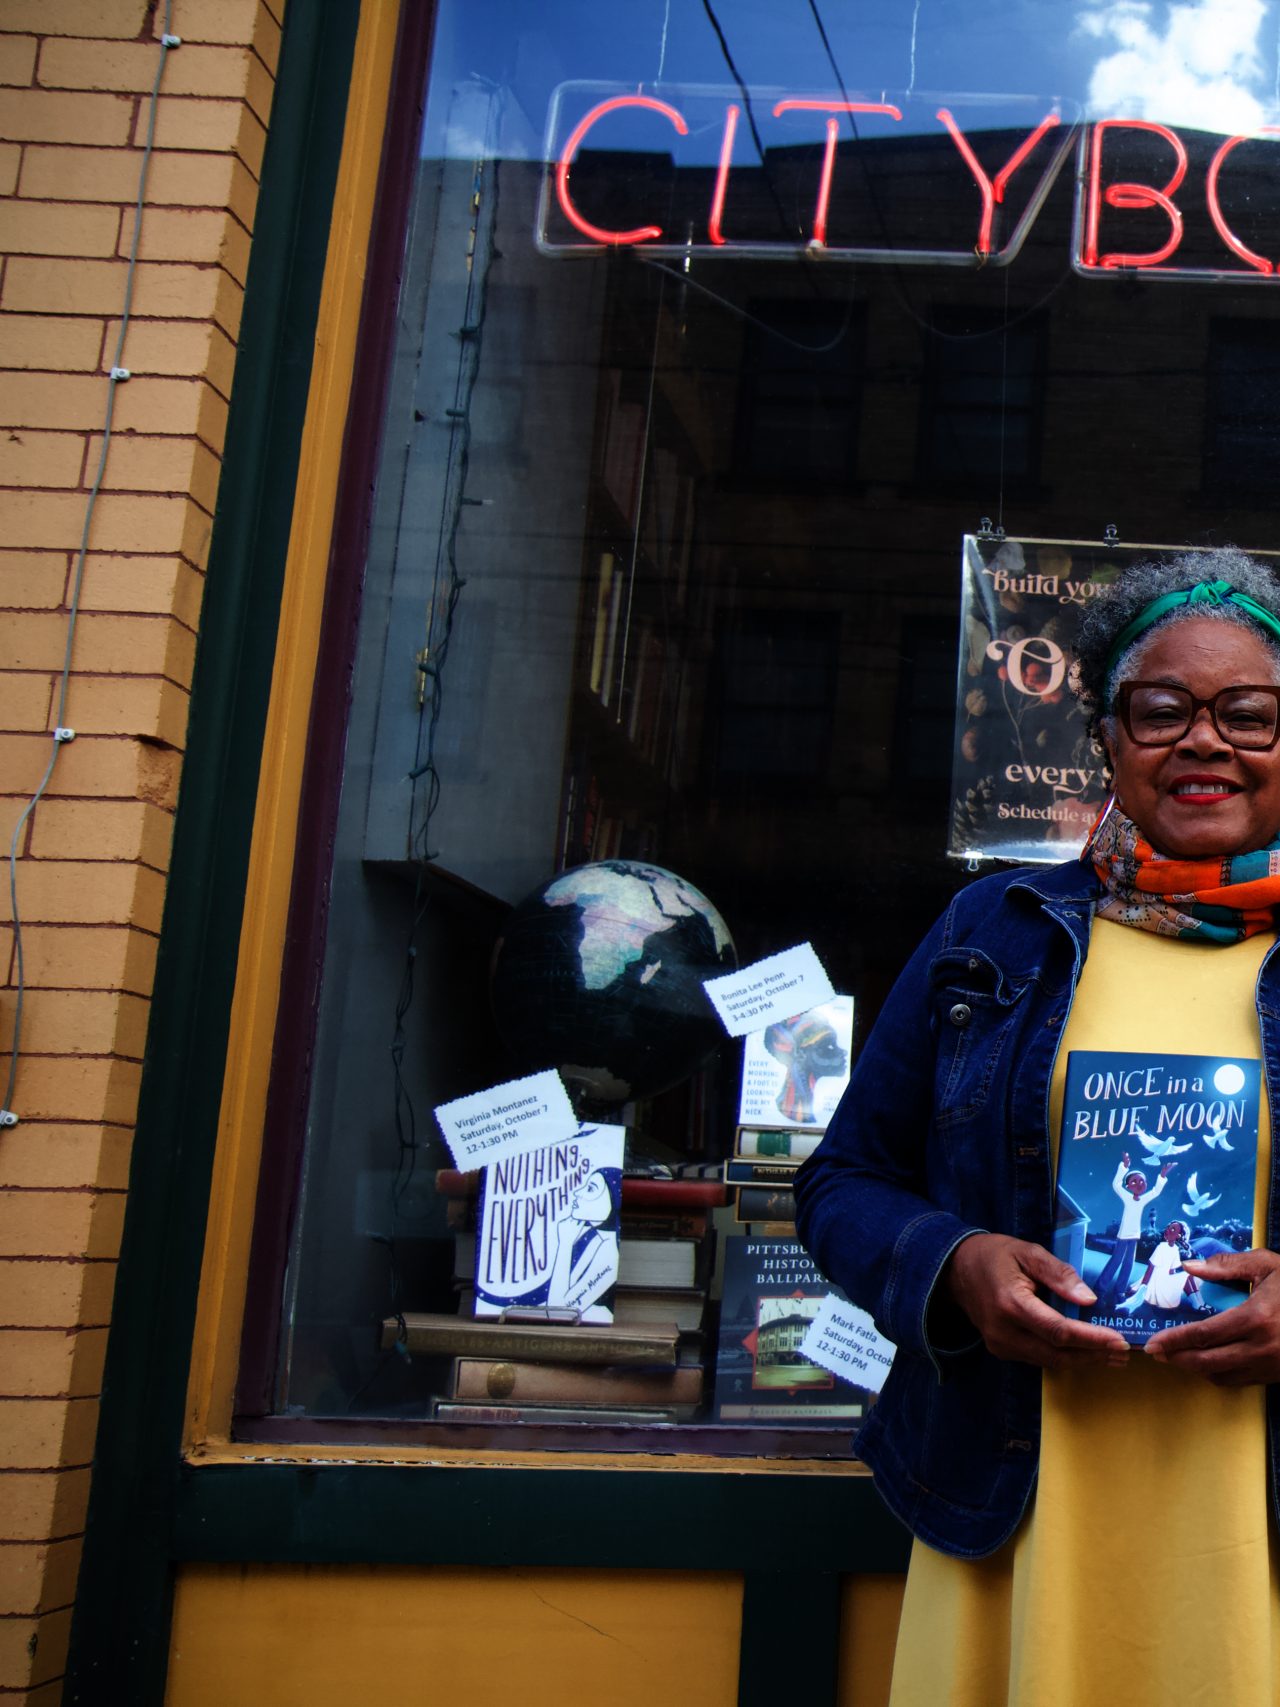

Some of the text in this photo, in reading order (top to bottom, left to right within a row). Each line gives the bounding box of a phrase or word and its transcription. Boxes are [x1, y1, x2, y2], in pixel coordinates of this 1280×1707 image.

[1005, 763, 1095, 794] every
[997, 802, 1079, 821] Schedule
[720, 971, 786, 1001] Bonita Lee Penn
[765, 978, 798, 997] October
[759, 1001, 774, 1012] PM
[1084, 1066, 1204, 1100] ONCE in a
[455, 1095, 538, 1129] Virginia Montanez
[460, 1104, 548, 1142] Saturday, October 7
[1073, 1099, 1247, 1140] BLUE MOON
[466, 1129, 519, 1154] 12-1:30 PM
[746, 1244, 809, 1255] PITTSBU
[763, 1259, 815, 1269] HISTO
[756, 1273, 829, 1284] BALLPAR
[830, 1313, 877, 1343] Mark Fatla
[1091, 1316, 1143, 1328] SHARON
[1149, 1319, 1160, 1329] G.
[816, 1340, 868, 1371] 12-1:30 PM
[823, 1326, 893, 1367] Saturday, Octob
